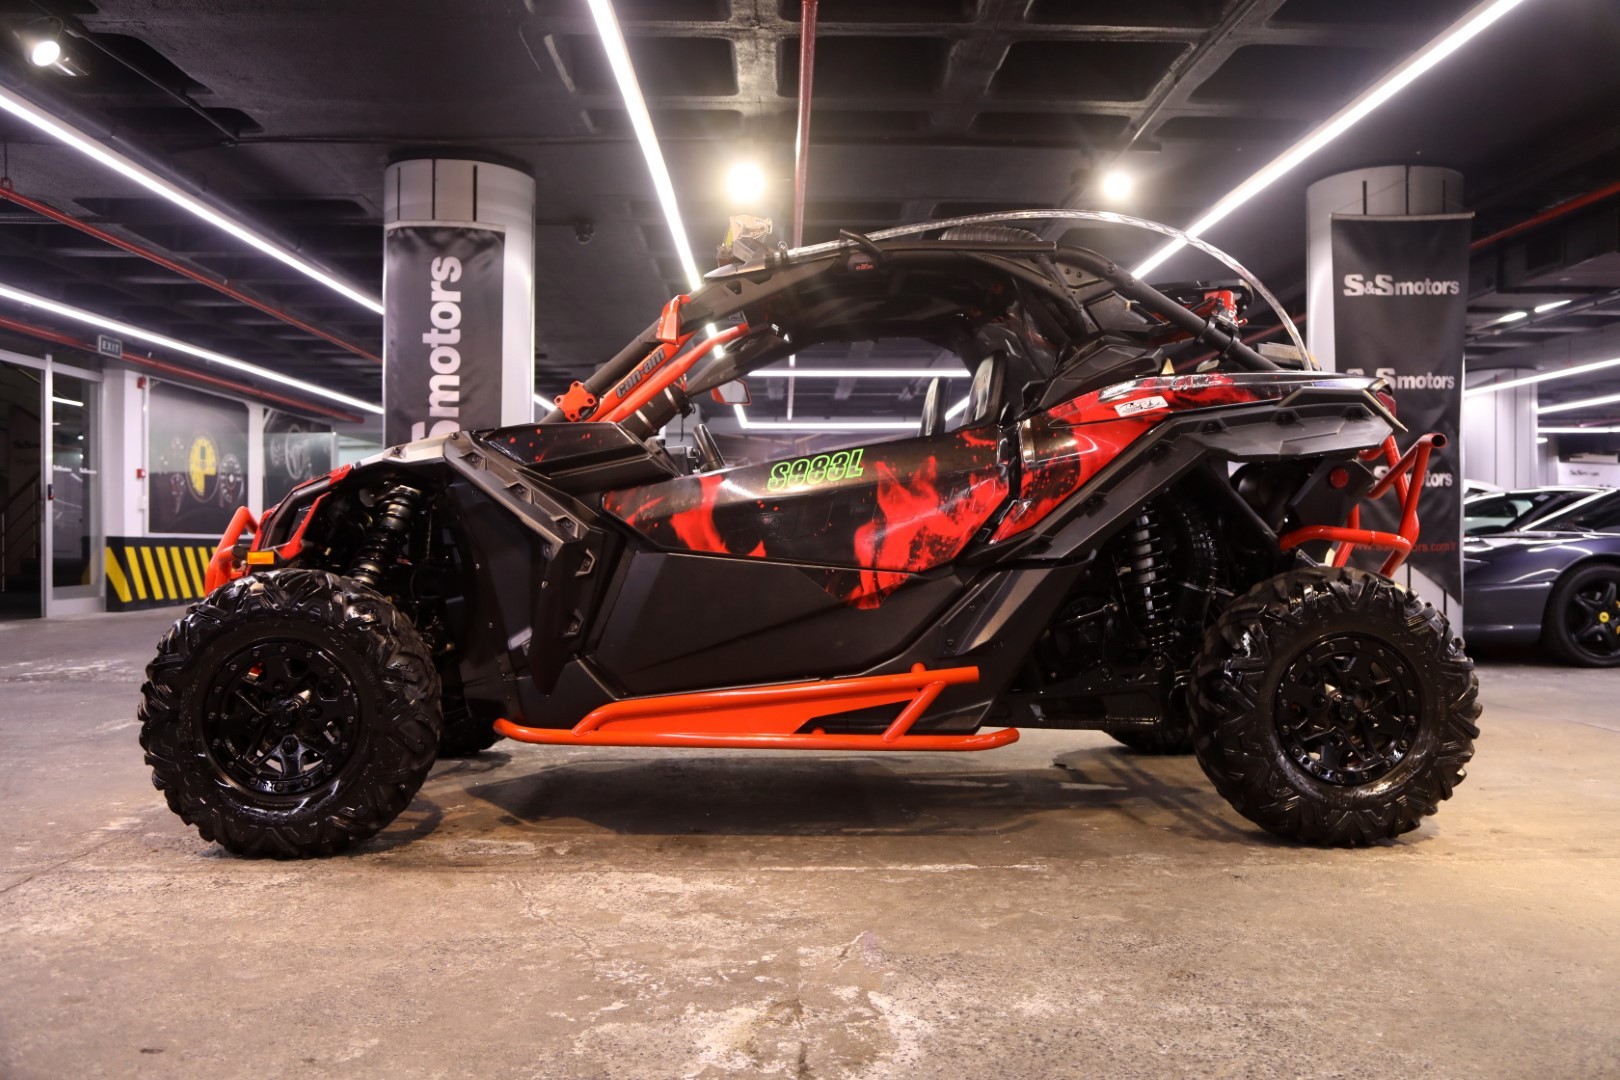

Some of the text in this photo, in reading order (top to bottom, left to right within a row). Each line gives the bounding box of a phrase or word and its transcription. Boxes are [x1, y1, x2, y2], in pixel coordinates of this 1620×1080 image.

[102, 340, 120, 352] EXIT
[616, 348, 665, 399] can-am
[767, 448, 864, 492] S983L
